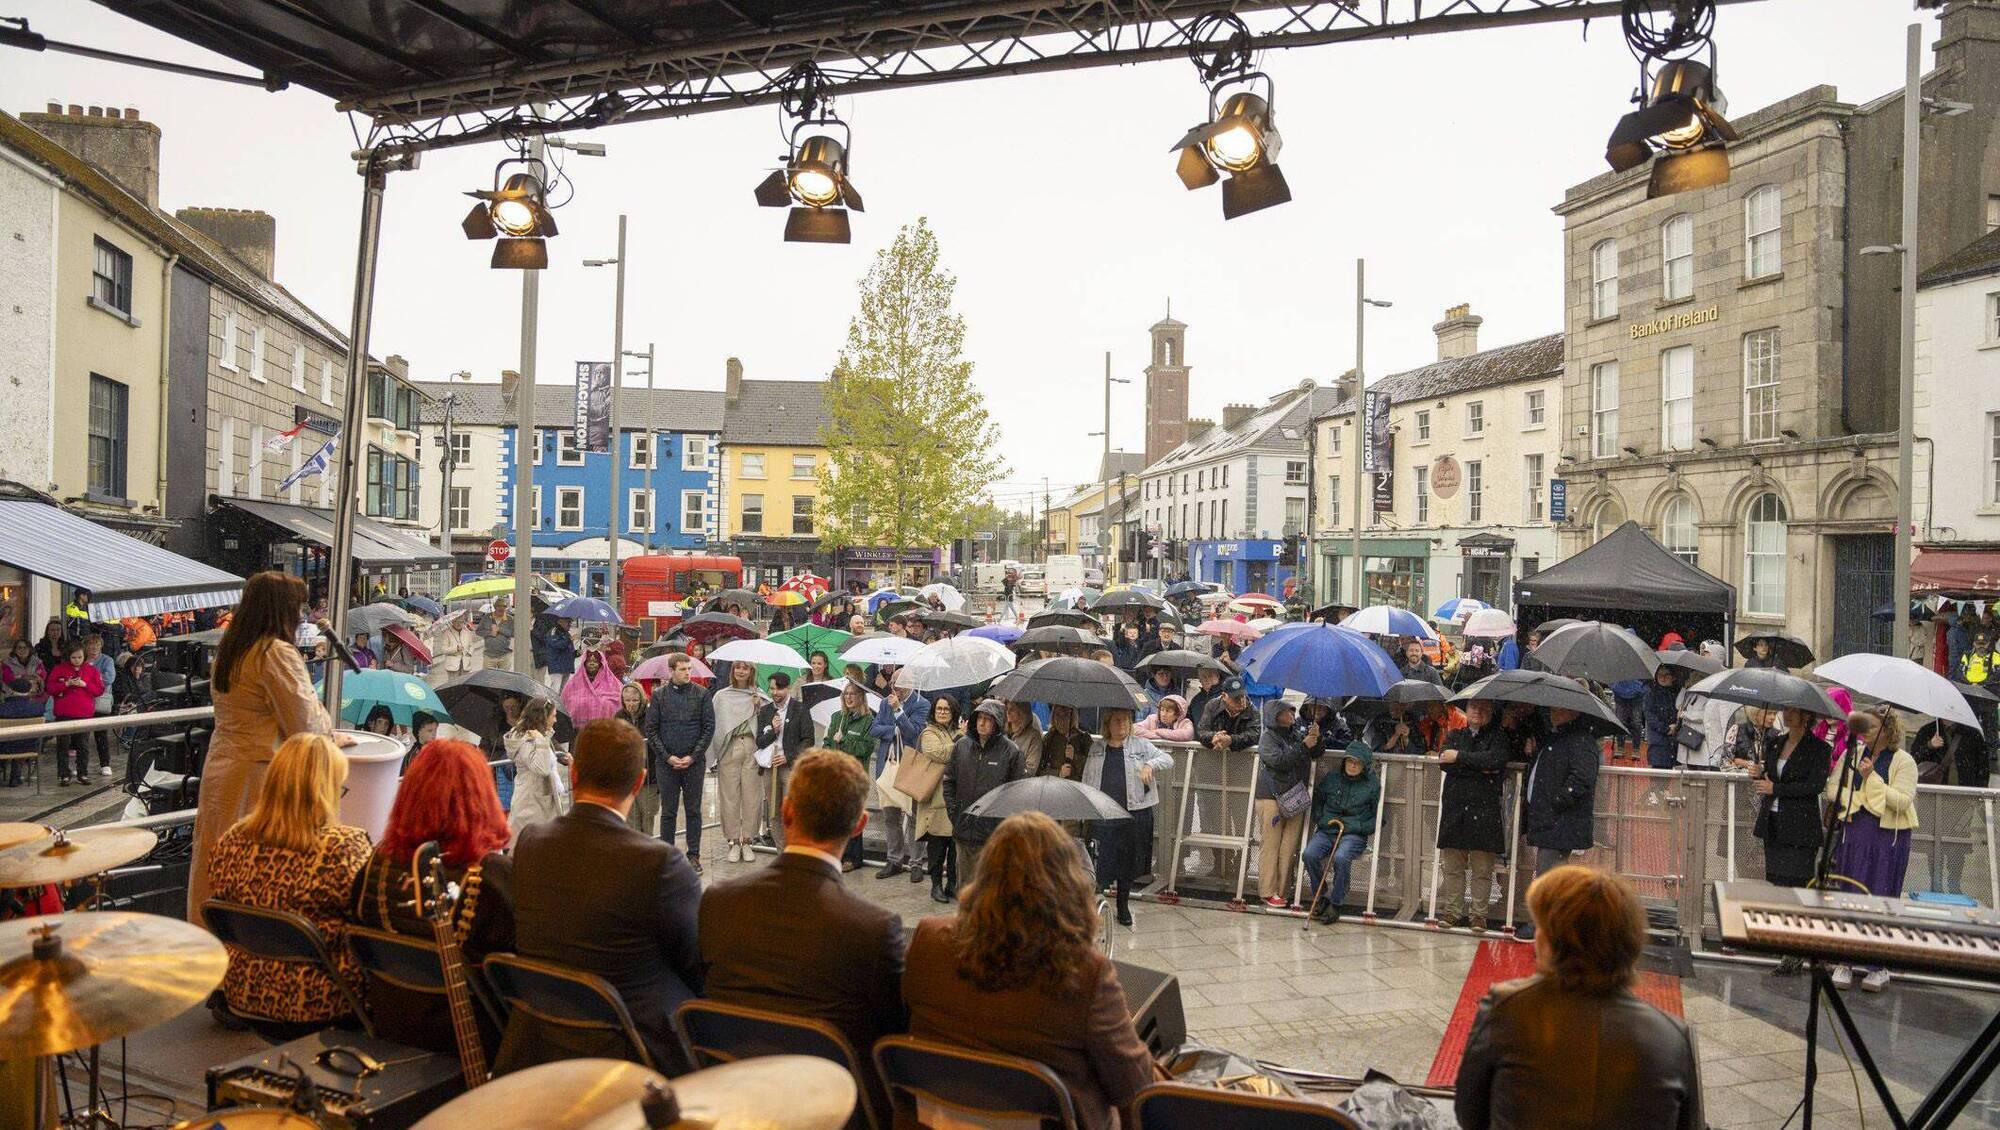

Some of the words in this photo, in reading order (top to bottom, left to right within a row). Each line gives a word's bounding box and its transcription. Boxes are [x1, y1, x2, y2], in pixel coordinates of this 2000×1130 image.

[1631, 319, 1660, 340] Bank
[1660, 314, 1674, 333] of
[1674, 304, 1718, 330] Ireland
[576, 364, 590, 449] SHACKLETON
[1364, 393, 1375, 470] SHACKLETON
[490, 546, 509, 556] STOP
